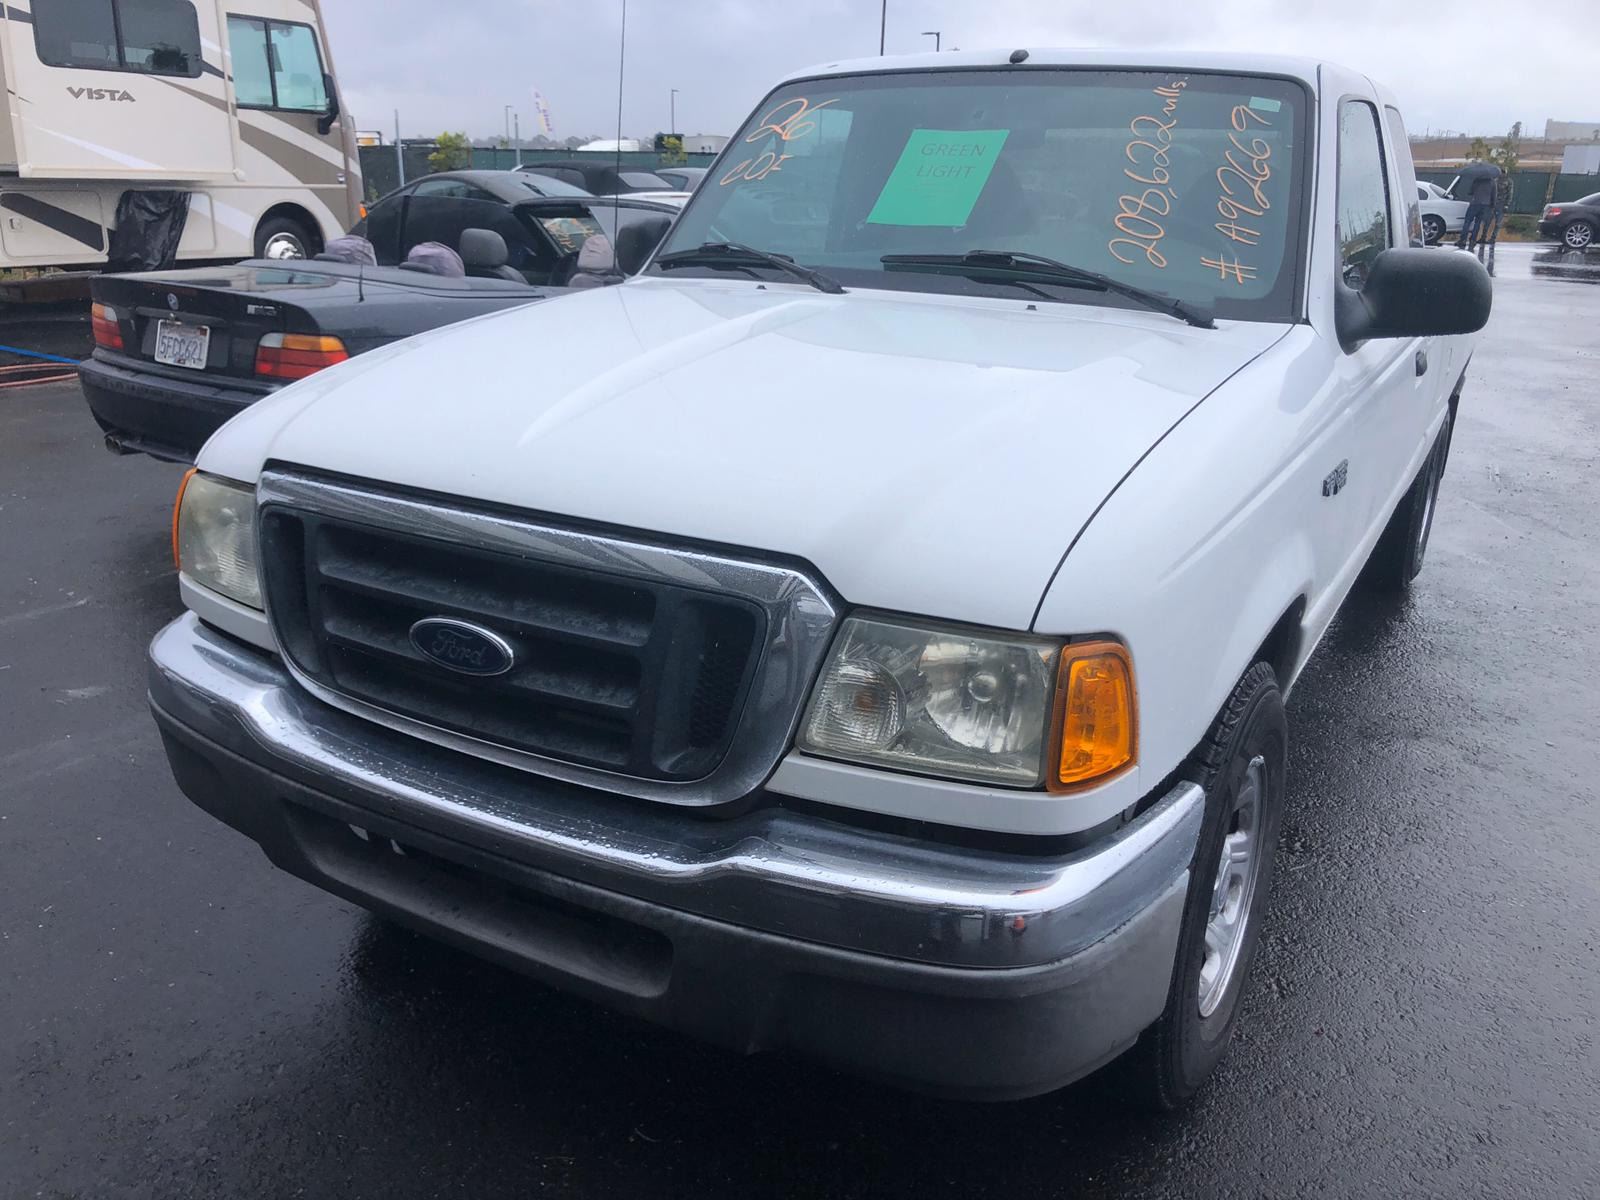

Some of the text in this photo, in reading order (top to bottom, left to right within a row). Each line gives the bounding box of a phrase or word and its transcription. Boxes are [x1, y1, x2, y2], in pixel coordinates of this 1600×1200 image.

[66, 86, 136, 102] VISTA
[921, 142, 987, 157] GREEN
[916, 164, 977, 179] LIGHT
[1108, 115, 1178, 268] 208,622
[431, 628, 488, 665] Ford
